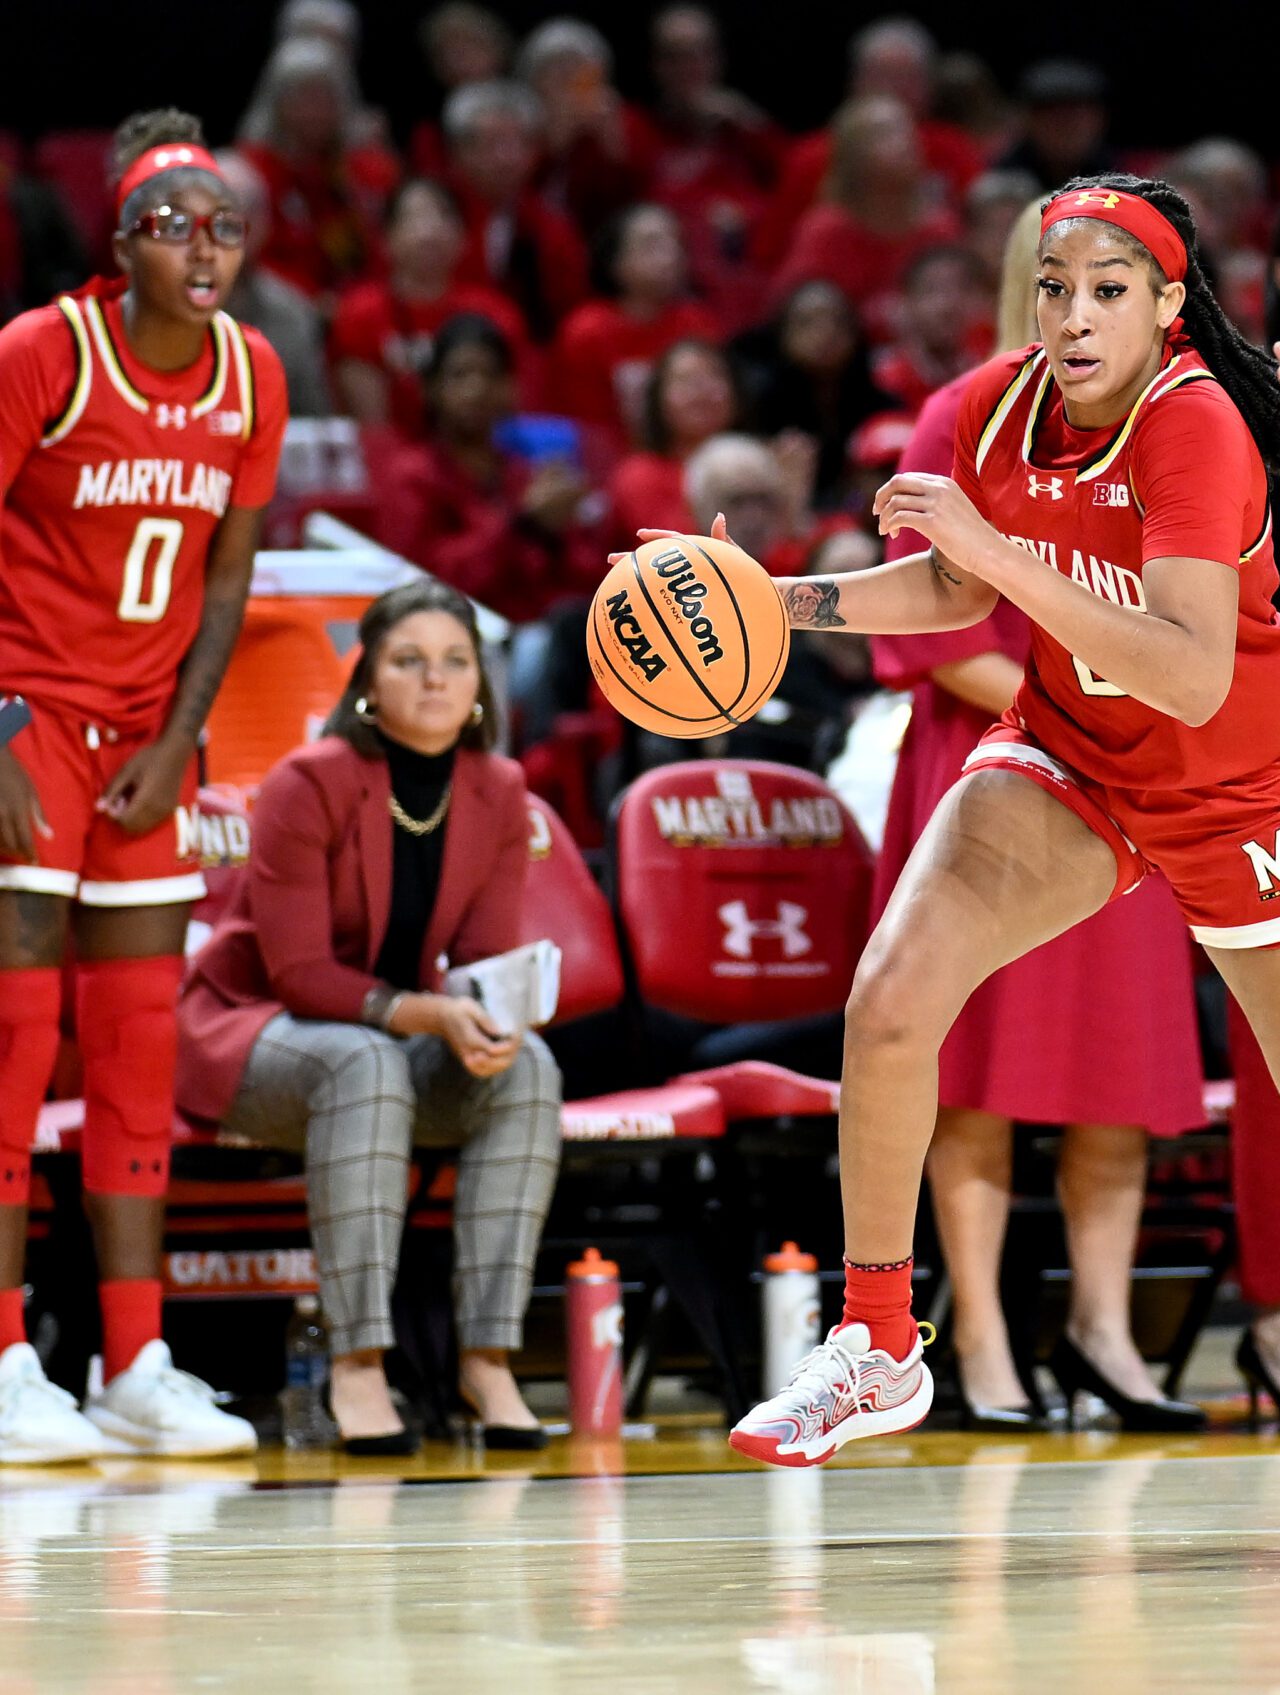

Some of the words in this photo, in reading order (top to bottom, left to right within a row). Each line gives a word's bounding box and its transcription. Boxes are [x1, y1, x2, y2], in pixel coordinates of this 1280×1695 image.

[1092, 482, 1130, 508] BIG
[117, 518, 184, 624] 0
[606, 589, 668, 683] NCAA
[650, 546, 724, 667] Wilson
[660, 588, 673, 606] EVO
[670, 606, 684, 625] NXT
[653, 796, 844, 841] MARYLAND
